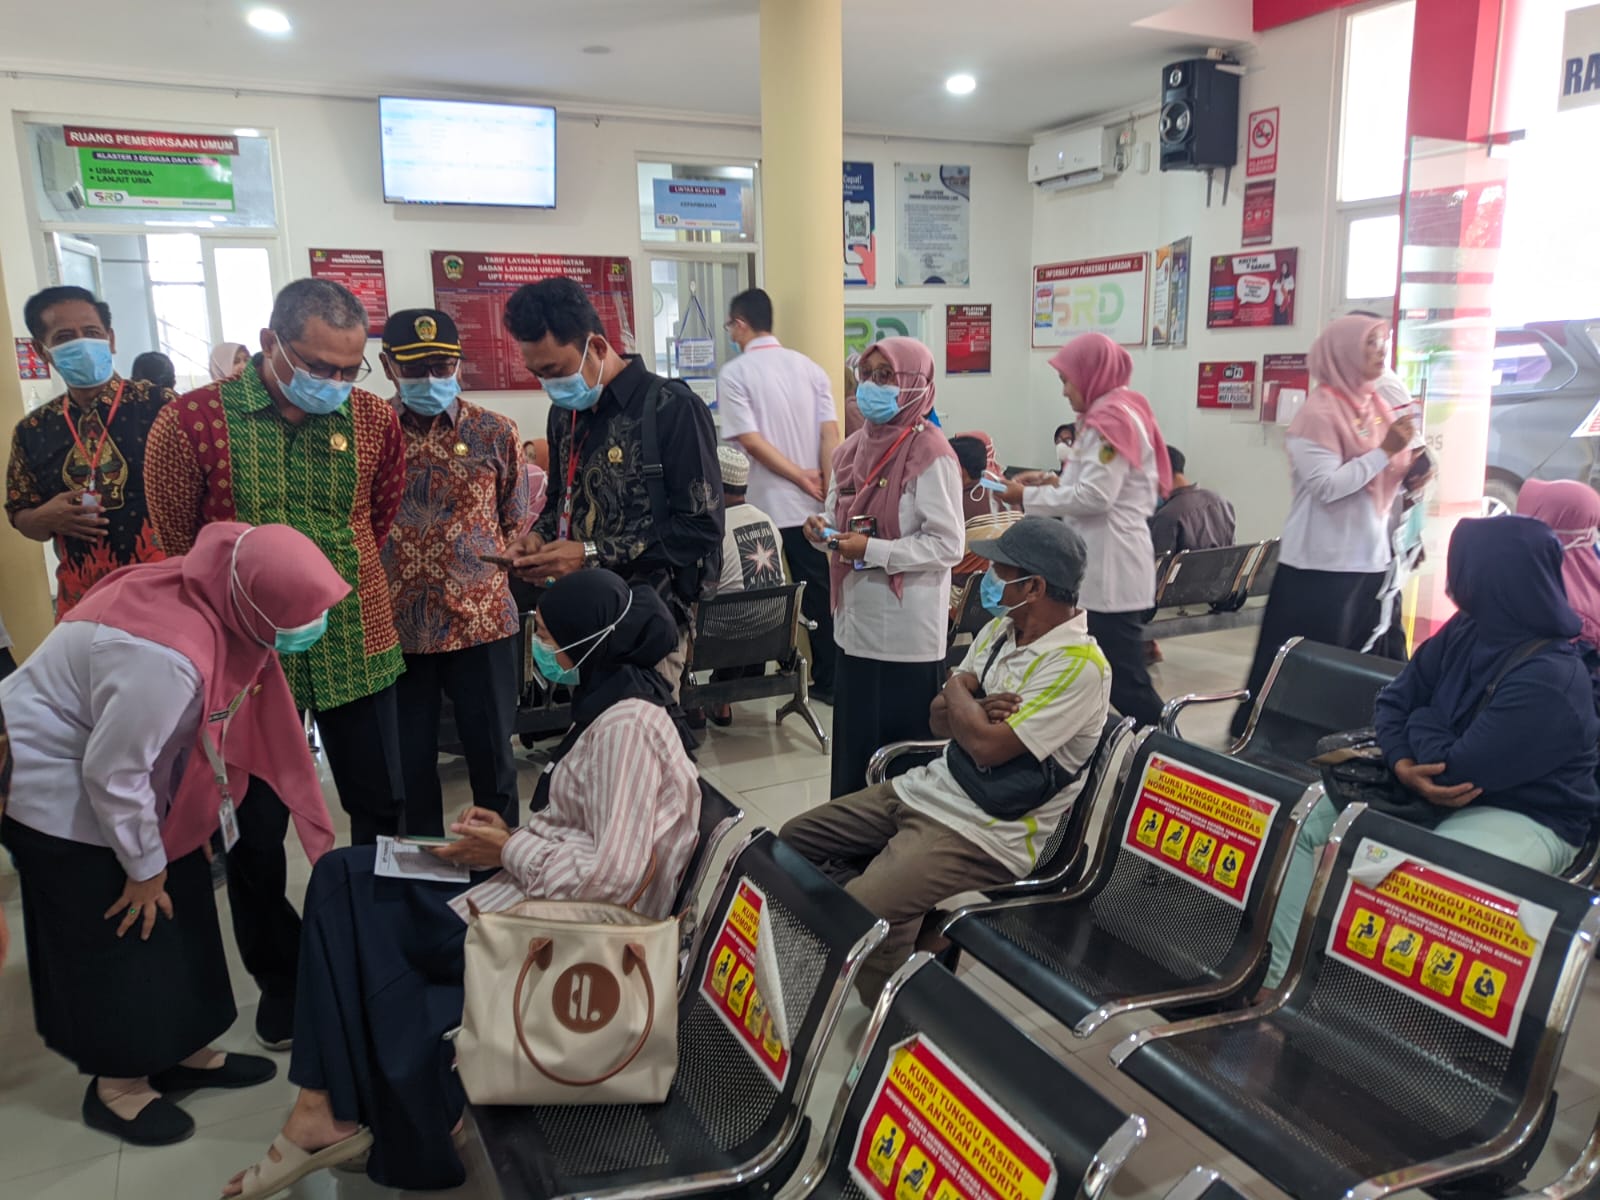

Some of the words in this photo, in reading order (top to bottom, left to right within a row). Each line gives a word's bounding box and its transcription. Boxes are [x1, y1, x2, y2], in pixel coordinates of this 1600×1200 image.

[70, 132, 113, 144] RUANG
[115, 134, 198, 148] PEMERIKSAAN
[200, 139, 234, 150] UMUM
[96, 152, 132, 160] KLASTER
[139, 155, 171, 163] DEWASA
[118, 168, 154, 176] DEWASA
[132, 176, 152, 184] USIA
[94, 192, 124, 202] SRD
[485, 256, 506, 264] TARIF
[507, 257, 541, 265] LAYANAN
[542, 258, 584, 266] KESEHATAN
[563, 267, 591, 275] DAERAH
[1108, 260, 1131, 272] SARADAN
[1054, 282, 1124, 326] SRD
[1148, 779, 1175, 796] NOMOR
[1177, 791, 1213, 813] ANTRIAN
[1215, 806, 1261, 832] PRIORITAS
[1160, 774, 1182, 790] KURSI
[1185, 785, 1219, 804] TUNGGU
[1222, 798, 1253, 819] PASIEN
[1414, 882, 1466, 911] TUNGGU
[1468, 905, 1515, 932] PASIEN
[732, 910, 752, 936] NOMOR
[1402, 888, 1456, 919] ANTRIAN
[1459, 914, 1529, 951] PRIORITAS
[893, 1067, 927, 1106] NOMOR
[927, 1102, 971, 1153] ANTRIAN
[972, 1147, 1028, 1200] PRIORITA
[908, 1063, 938, 1098] KURSI
[939, 1090, 982, 1141] TUNGGU
[983, 1137, 1024, 1183] PASIEN
